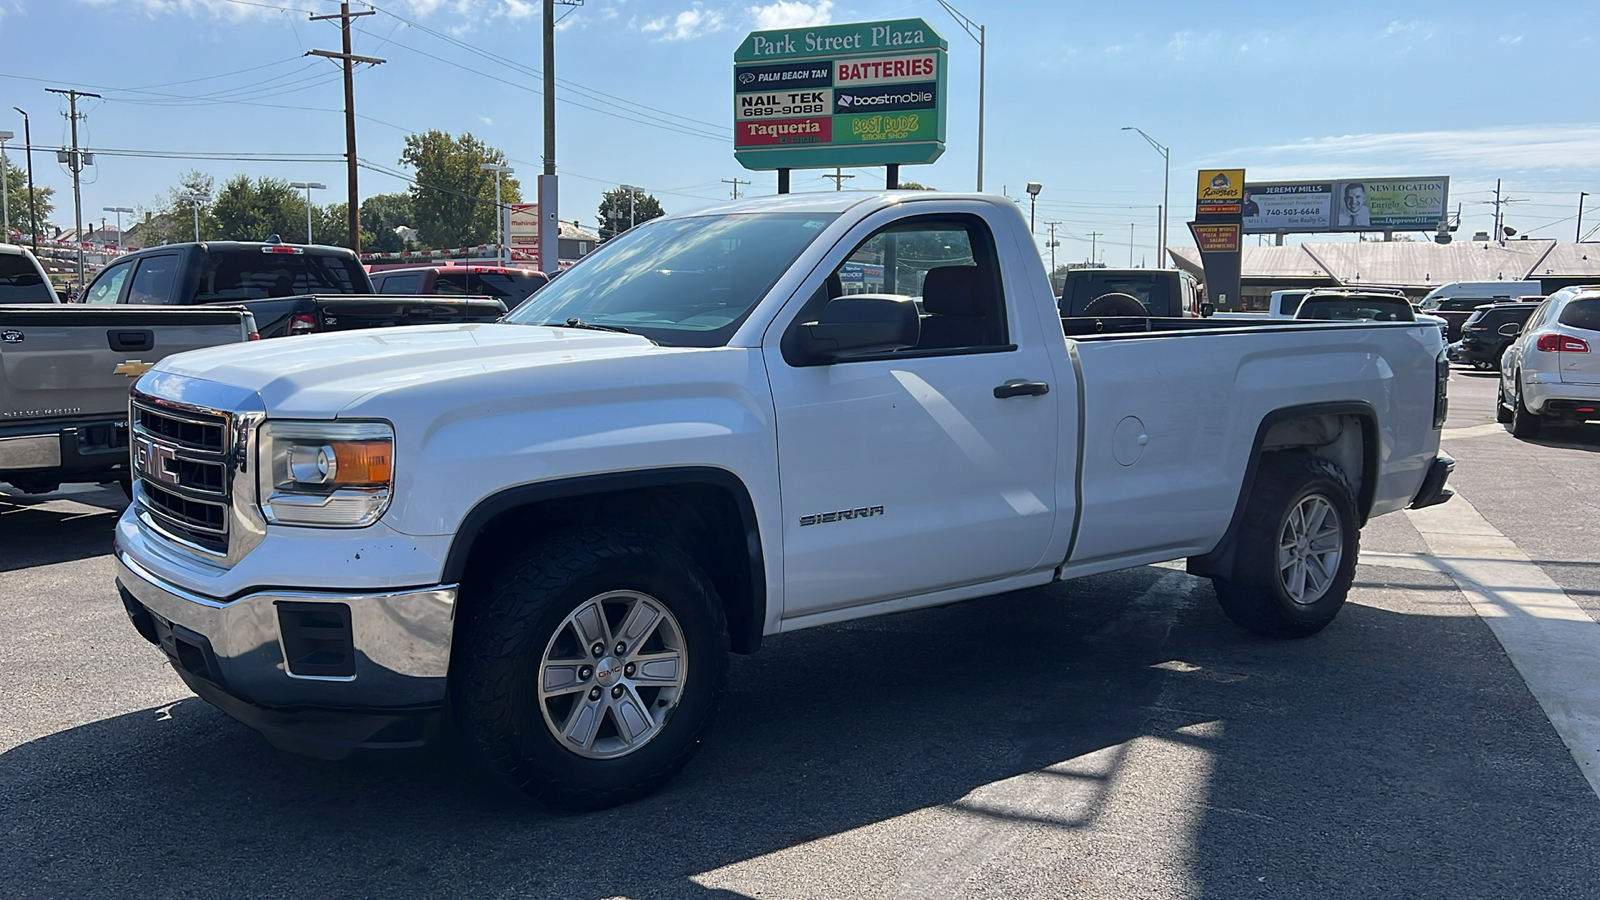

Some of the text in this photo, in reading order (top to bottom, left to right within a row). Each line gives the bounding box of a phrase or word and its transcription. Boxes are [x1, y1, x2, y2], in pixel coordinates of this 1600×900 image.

[753, 25, 925, 56] Park Street Plaza
[758, 69, 828, 82] PALM BEACH TAN
[839, 58, 934, 81] BATTERIES
[742, 92, 824, 108] NAIL TEK
[743, 104, 823, 117] 689-9088
[884, 114, 919, 132] BUDZ
[861, 131, 908, 141] SMOKE SHOP
[1266, 186, 1297, 194] JEREMY
[1369, 184, 1390, 192] NEW
[1371, 200, 1401, 209] Enright
[1266, 208, 1320, 216] 740-503-6648
[134, 436, 180, 484] GMC
[799, 505, 884, 527] SIERRA
[598, 666, 621, 678] GMC
